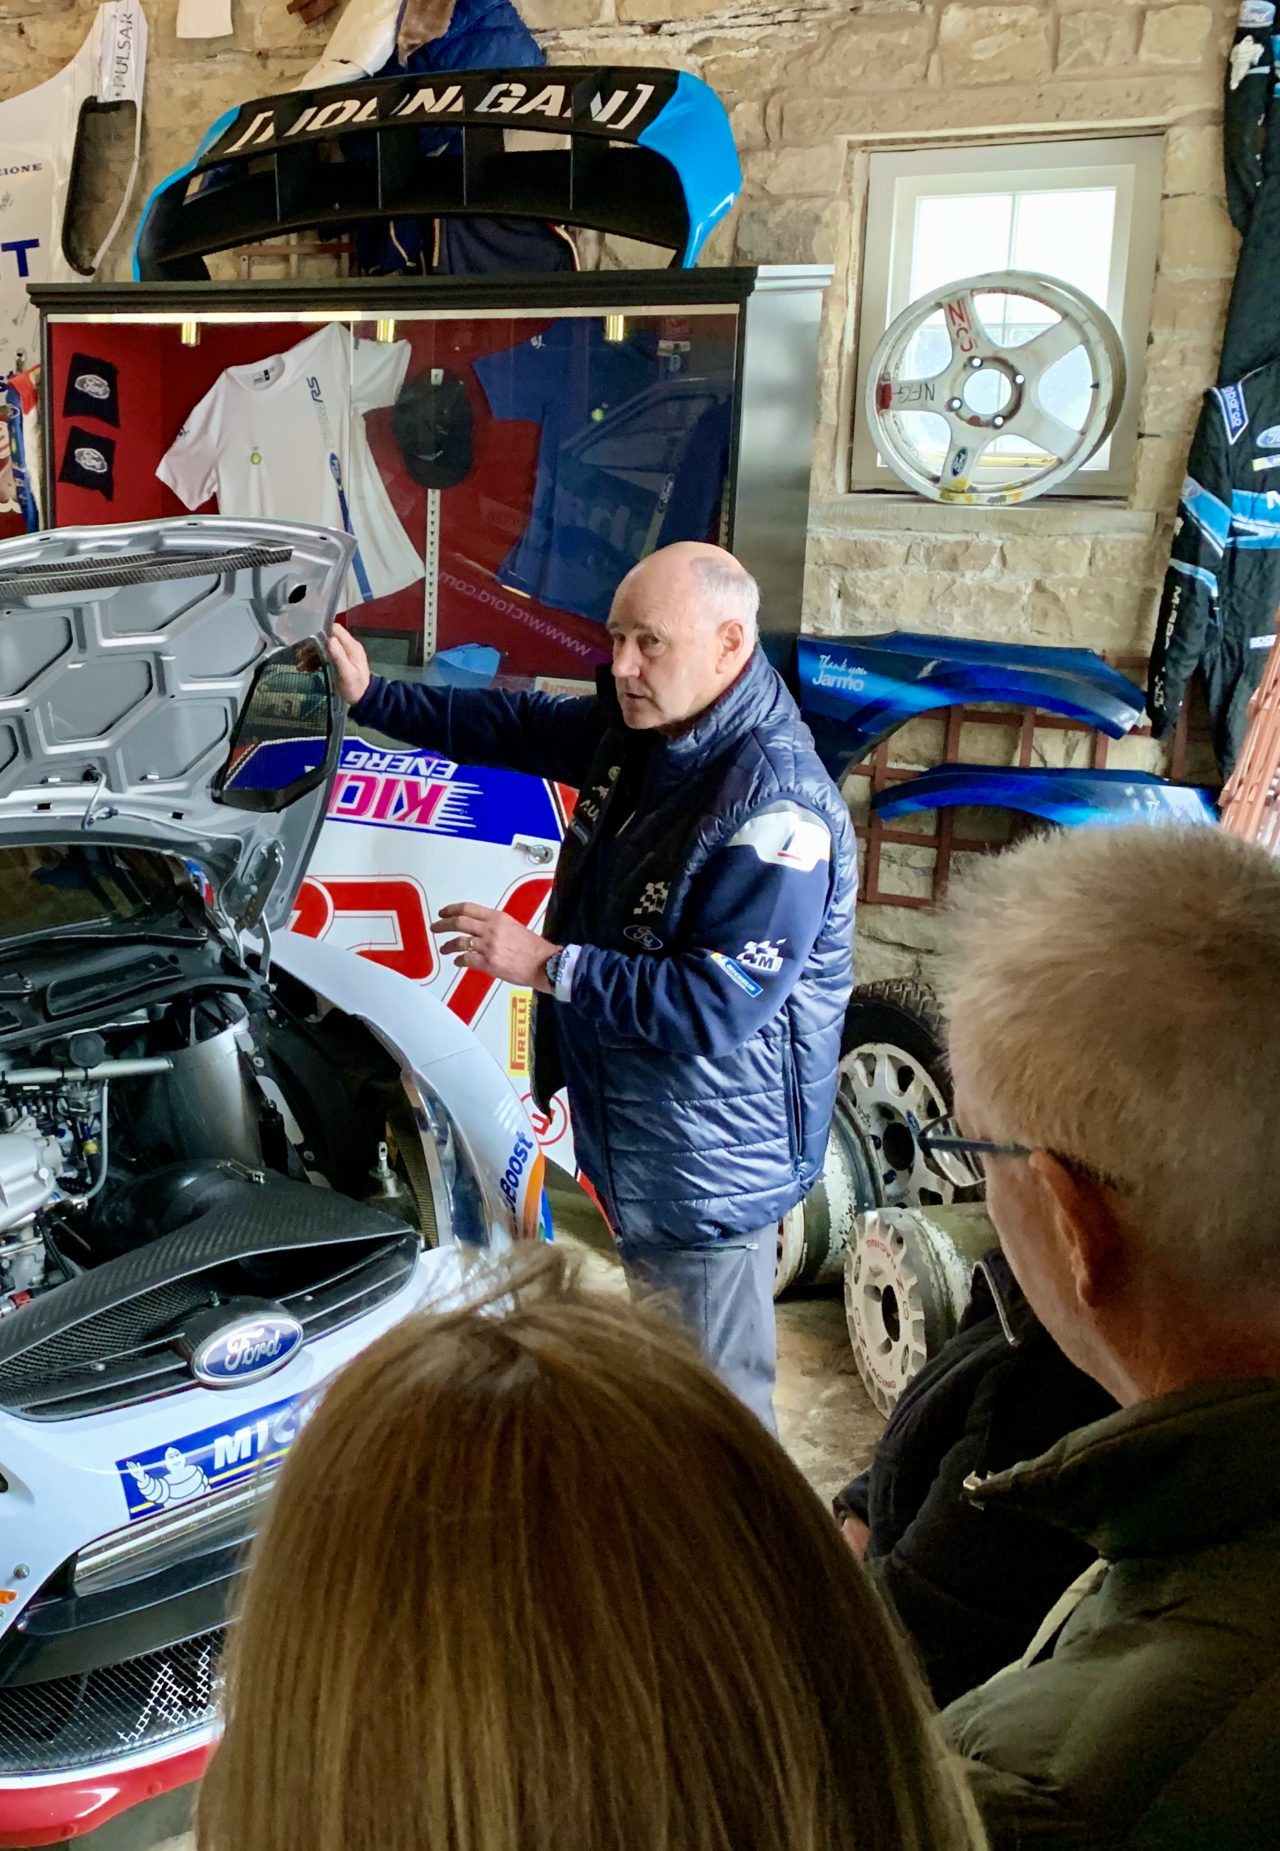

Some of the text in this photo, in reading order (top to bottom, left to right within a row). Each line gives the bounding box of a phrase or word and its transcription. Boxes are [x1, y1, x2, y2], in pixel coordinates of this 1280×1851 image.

[113, 13, 133, 89] PULSAR
[812, 670, 865, 692] Jarmo
[339, 750, 459, 780] ENERG
[328, 773, 448, 826] KIC
[510, 996, 528, 1071] PIRELLI
